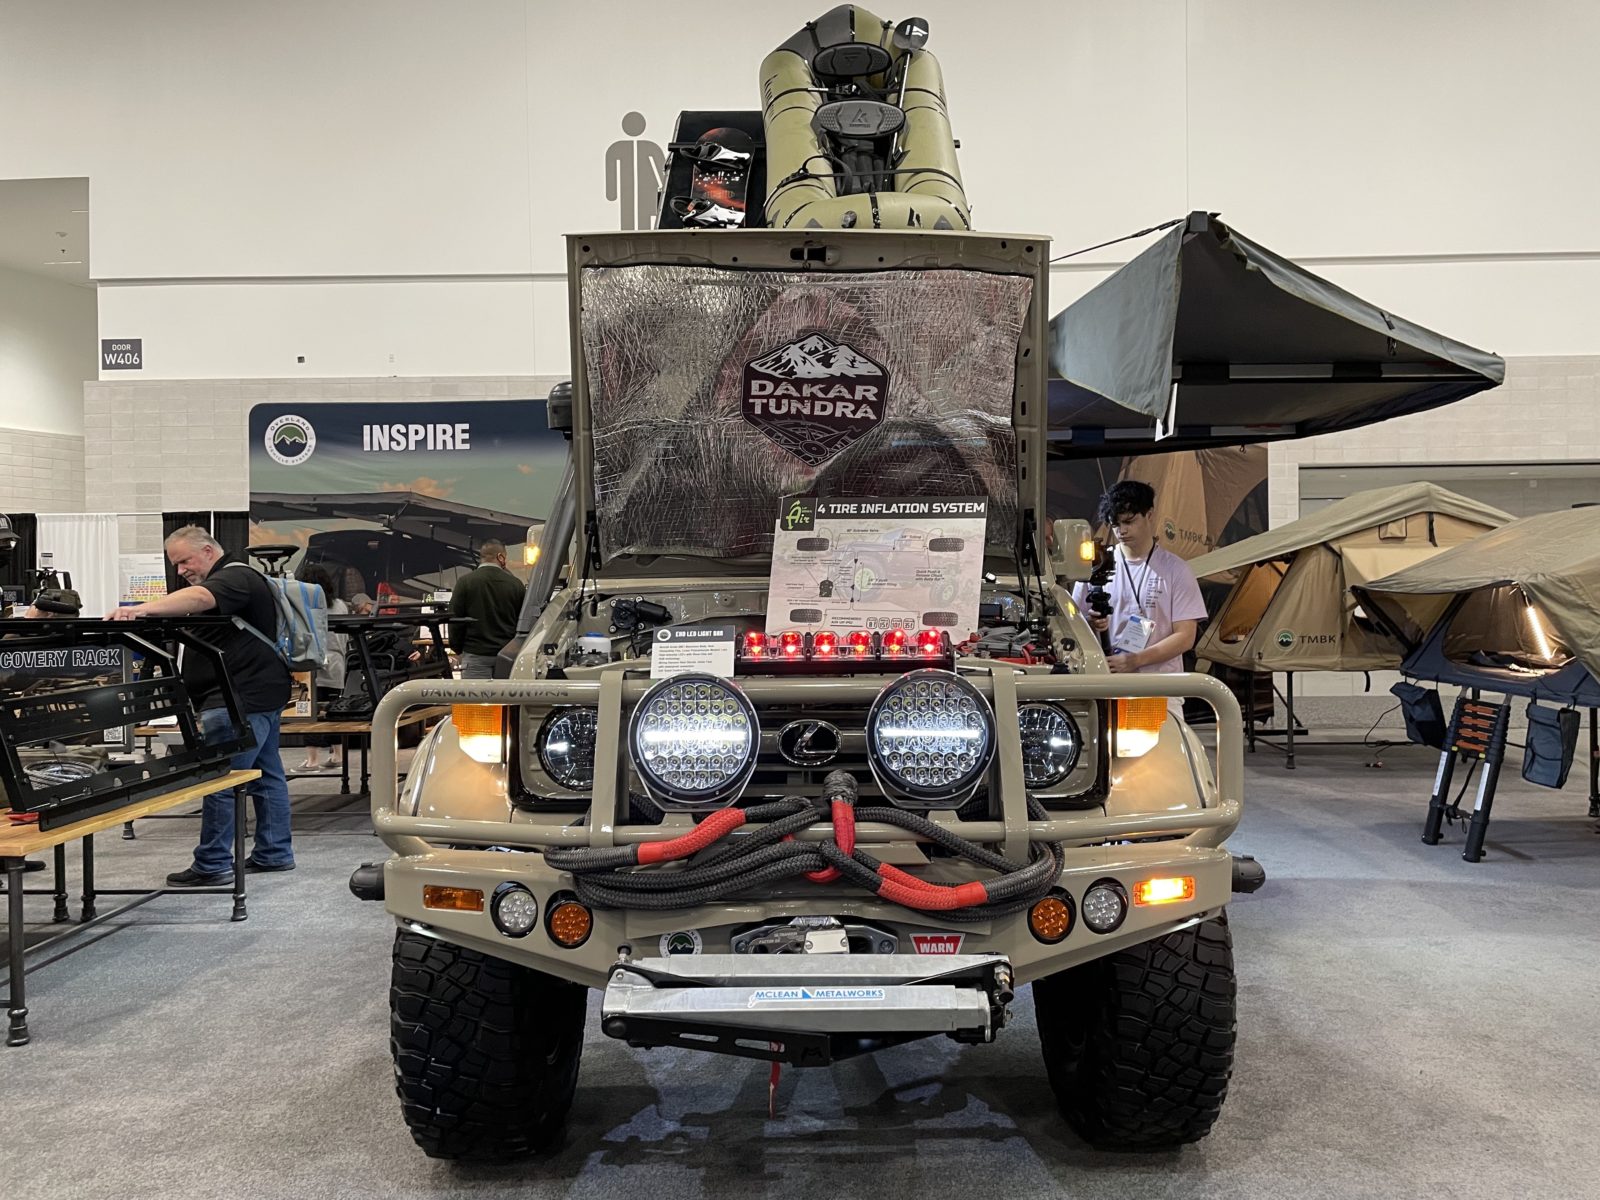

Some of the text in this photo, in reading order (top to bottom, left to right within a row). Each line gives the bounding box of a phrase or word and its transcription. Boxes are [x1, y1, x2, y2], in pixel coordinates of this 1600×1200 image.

[111, 343, 131, 351] DOOR
[104, 352, 140, 365] W406
[750, 380, 879, 401] DAKAR
[749, 398, 877, 420] TUNDRA
[270, 417, 310, 430] OVERLAND
[363, 423, 471, 451] INSPIRE
[817, 503, 826, 514] 4
[829, 503, 858, 514] TIRE
[860, 502, 929, 514] INFLATION
[932, 502, 985, 513] SYSTEM
[1299, 635, 1337, 644] TMBK
[72, 649, 120, 667] RACK
[920, 943, 954, 953] WARN
[755, 990, 798, 998] MCLEAN
